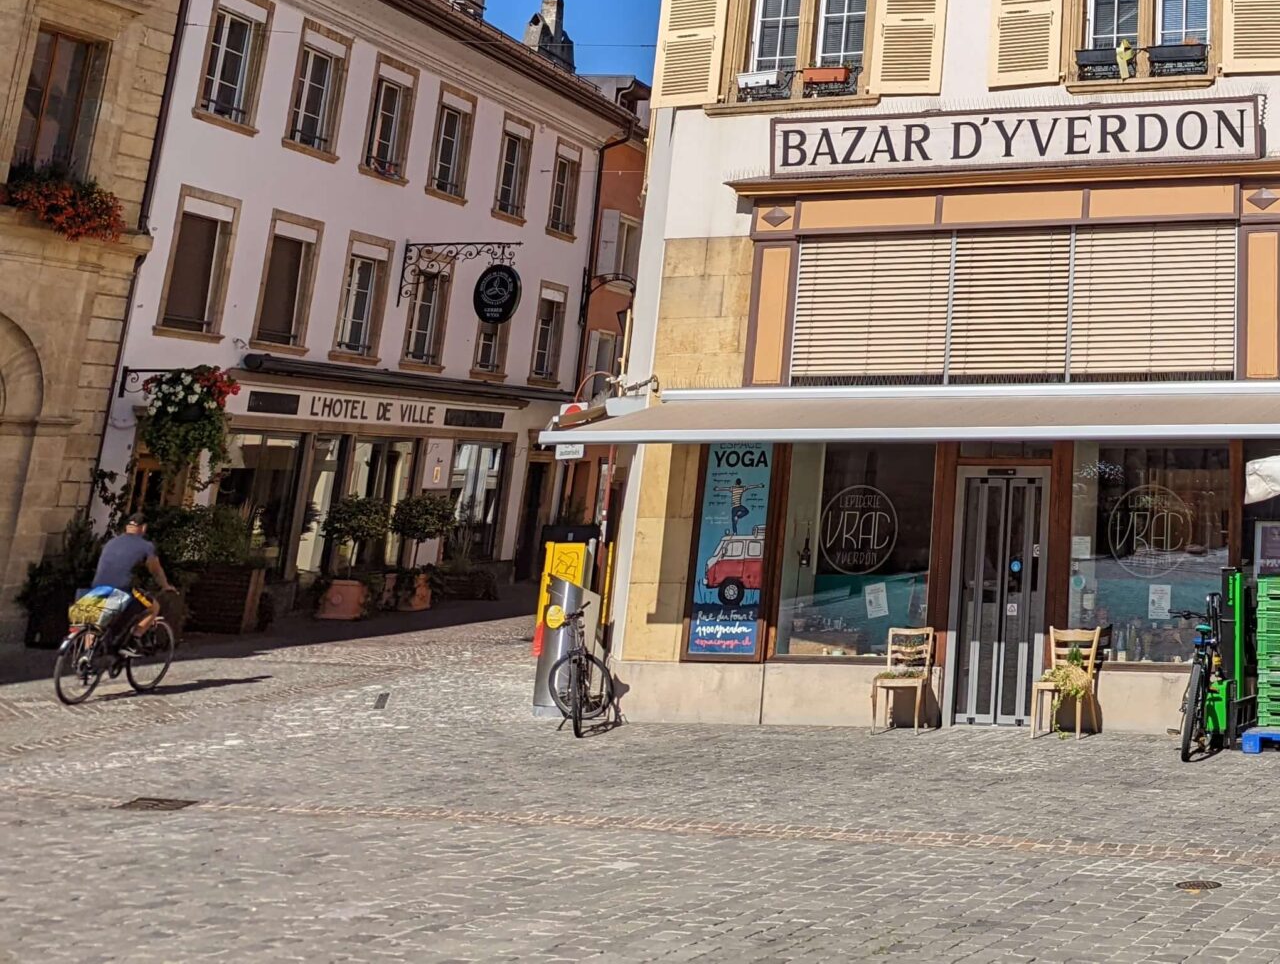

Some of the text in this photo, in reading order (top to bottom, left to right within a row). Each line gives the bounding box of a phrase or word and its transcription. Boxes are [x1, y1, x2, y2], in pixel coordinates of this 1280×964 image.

[779, 108, 1247, 167] BAZAR D'YVERDON
[310, 395, 436, 424] L'HOTEL DE VILLE
[714, 450, 769, 468] YOGA
[826, 510, 891, 550] VRAC
[1116, 511, 1184, 551] VRAC
[696, 610, 715, 625] Rue
[716, 609, 730, 622] du
